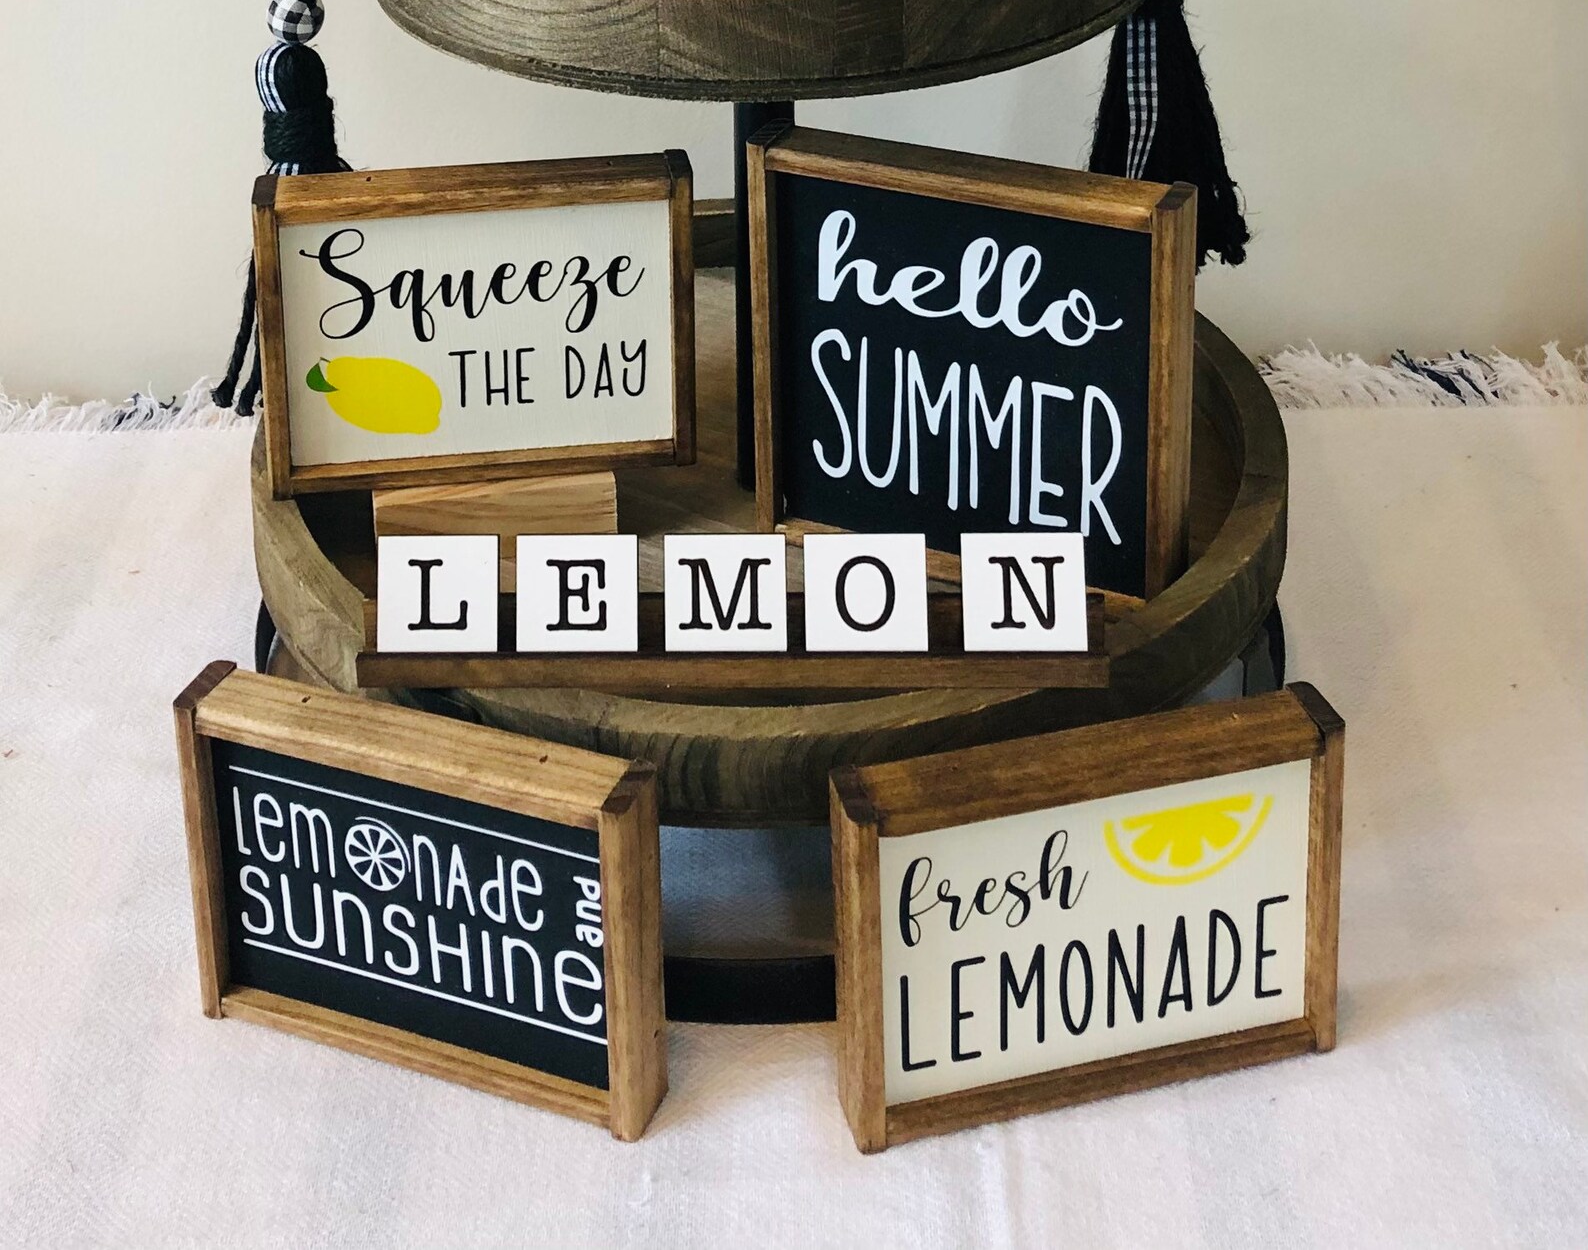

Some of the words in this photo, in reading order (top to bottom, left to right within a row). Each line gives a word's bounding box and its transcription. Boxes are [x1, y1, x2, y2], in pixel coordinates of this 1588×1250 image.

[299, 228, 646, 342] Squeeze
[818, 209, 1123, 347] hello
[448, 347, 536, 408] THE
[565, 339, 647, 399] DAY
[811, 328, 1123, 545] SUMMER
[899, 829, 1089, 948] fresh
[899, 894, 1290, 1072] LEMONADE
